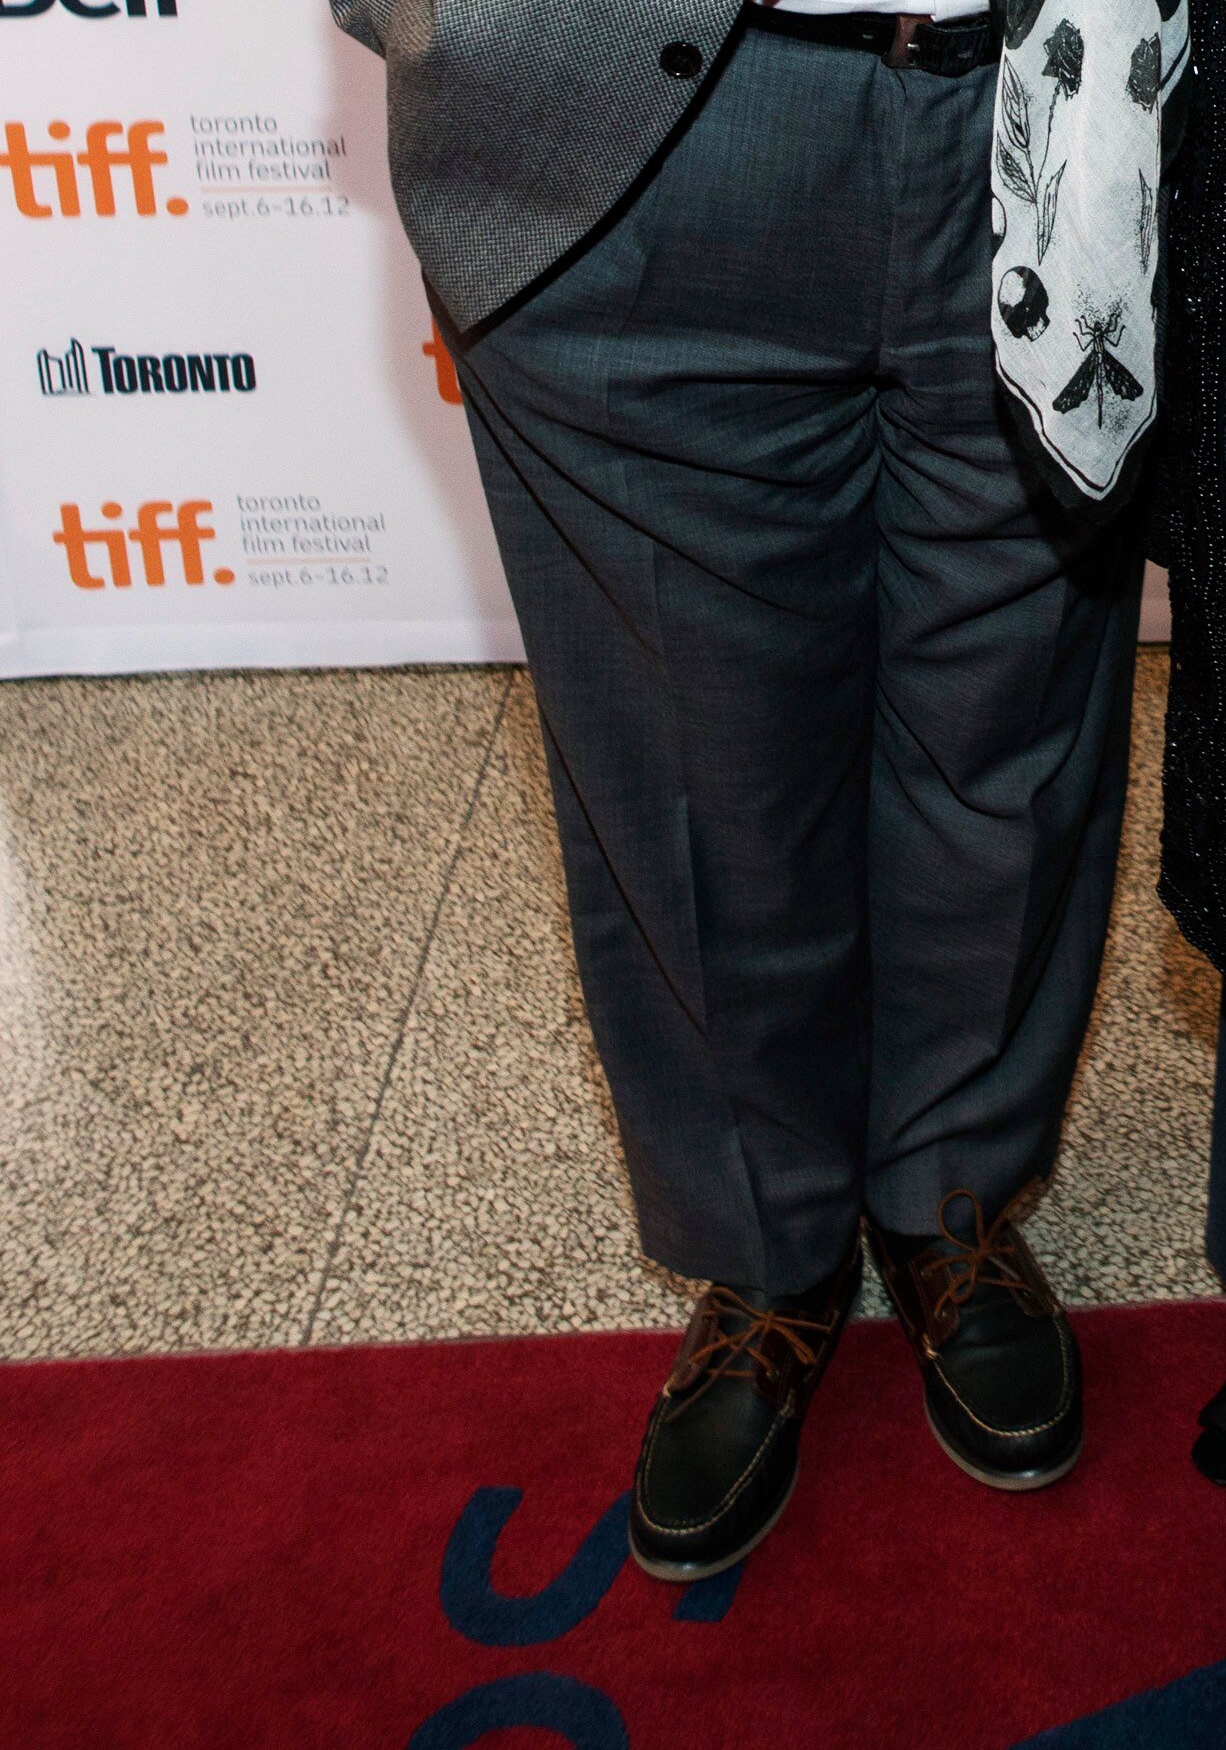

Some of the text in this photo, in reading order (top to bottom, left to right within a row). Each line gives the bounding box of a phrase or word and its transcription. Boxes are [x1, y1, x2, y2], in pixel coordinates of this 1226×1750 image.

[190, 114, 277, 134] toronto
[194, 136, 347, 158] international
[196, 160, 331, 181] film festival
[92, 346, 257, 394] TORONTO
[237, 494, 320, 513] toronto
[240, 514, 386, 533] international
[242, 534, 370, 555] film festival
